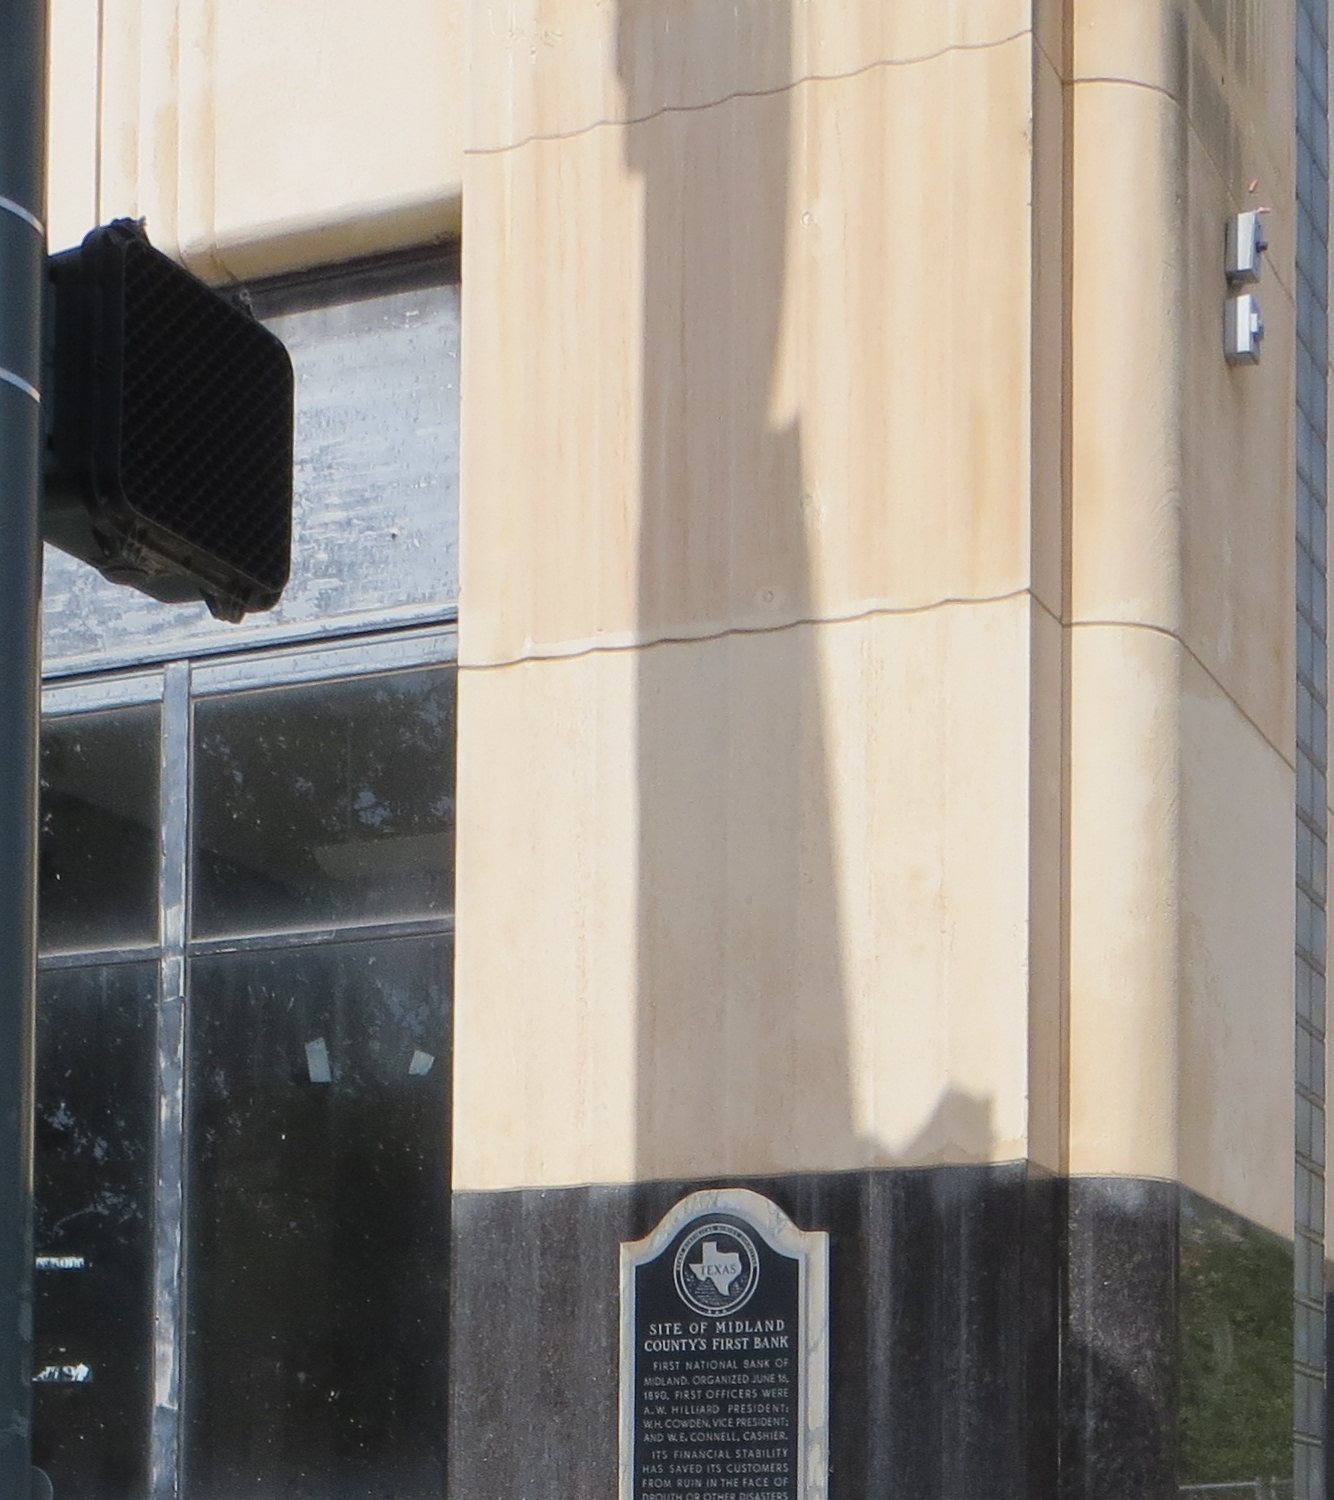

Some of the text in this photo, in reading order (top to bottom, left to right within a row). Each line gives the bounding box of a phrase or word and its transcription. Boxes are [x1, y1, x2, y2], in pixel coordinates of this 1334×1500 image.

[700, 1264, 736, 1275] TEXAS
[649, 1320, 785, 1335] SITE OF MIDLAND
[644, 1336, 788, 1352] COUNTY'S FIRST BANK
[653, 1358, 788, 1371] FIRST NATIONAL BANK OF
[692, 1375, 749, 1385] ORGANIZED
[752, 1374, 775, 1384] JUNE
[675, 1390, 702, 1400] FIRST
[706, 1389, 757, 1399] OFFICERS
[761, 1388, 788, 1398] WERE
[712, 1418, 733, 1427] VICE
[643, 1433, 664, 1443] AND
[652, 1449, 788, 1460] ITS FINANCIAL STABILITY
[642, 1463, 789, 1474] HAS SAVED ITS CUSTOMERS
[642, 1477, 789, 1488] FROM RUIN IN THE FACE OF
[686, 1492, 700, 1500] OR
[703, 1492, 735, 1500] OTHER
[739, 1492, 788, 1500] DISASTERS
